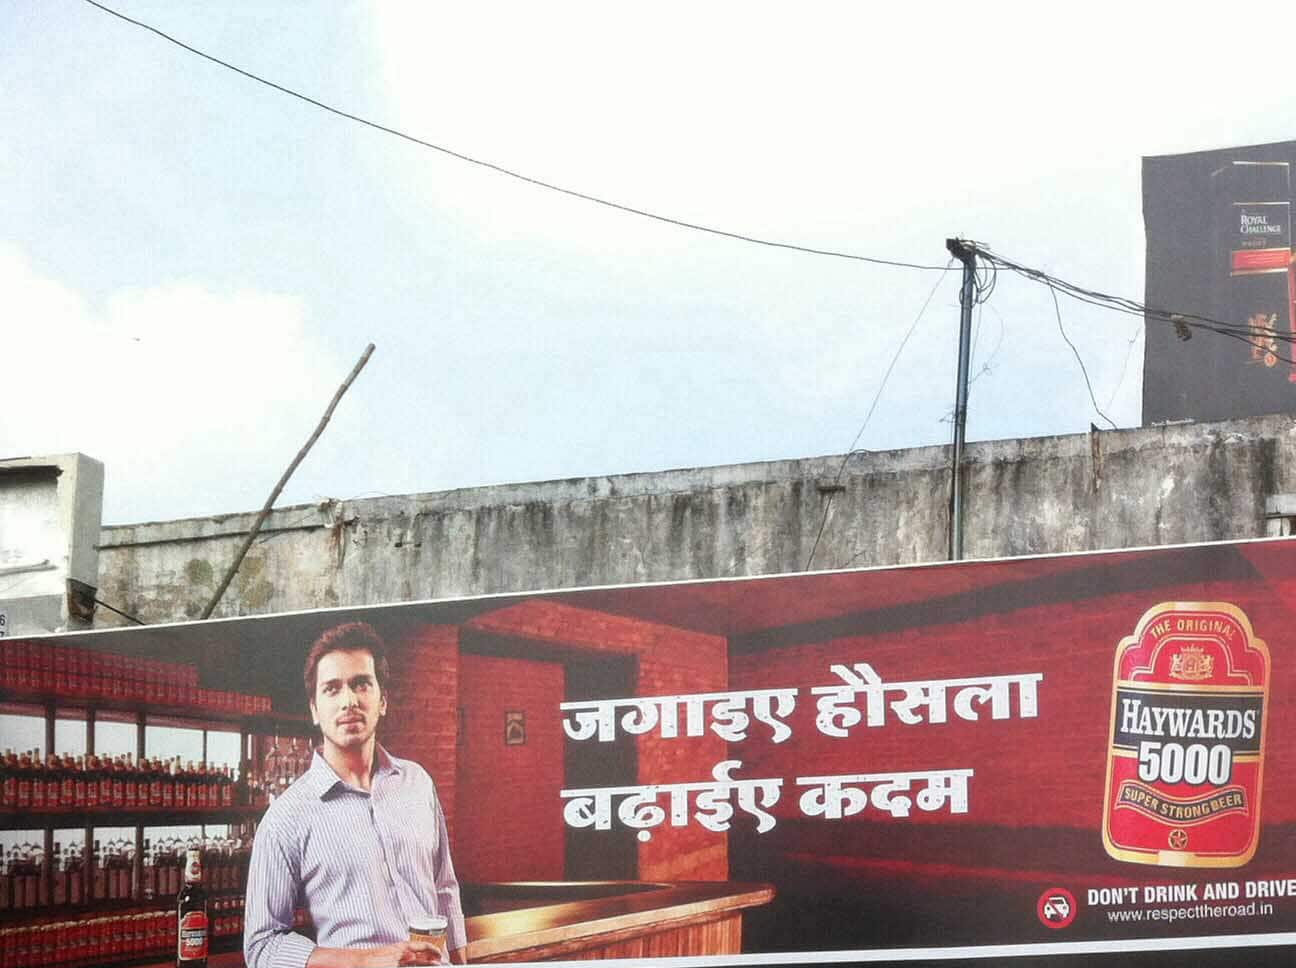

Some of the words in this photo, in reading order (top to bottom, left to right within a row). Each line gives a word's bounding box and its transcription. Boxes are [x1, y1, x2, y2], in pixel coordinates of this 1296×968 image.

[1150, 619, 1172, 639] THE
[1176, 618, 1237, 641] ORIGINAL
[560, 687, 799, 744] जगाइए
[811, 663, 1043, 738] हौसला
[1119, 698, 1257, 740] HAYWARDS
[1138, 740, 1232, 785] 5000
[796, 768, 974, 819] कदम
[1123, 786, 1159, 810] SUPER
[1160, 799, 1211, 820] STRONG
[1211, 793, 1243, 813] BEER
[1087, 886, 1139, 907] DON'T
[1144, 884, 1199, 905] DRINK
[1204, 882, 1240, 902] AND
[1107, 901, 1274, 923] www.respecttheroad.in
